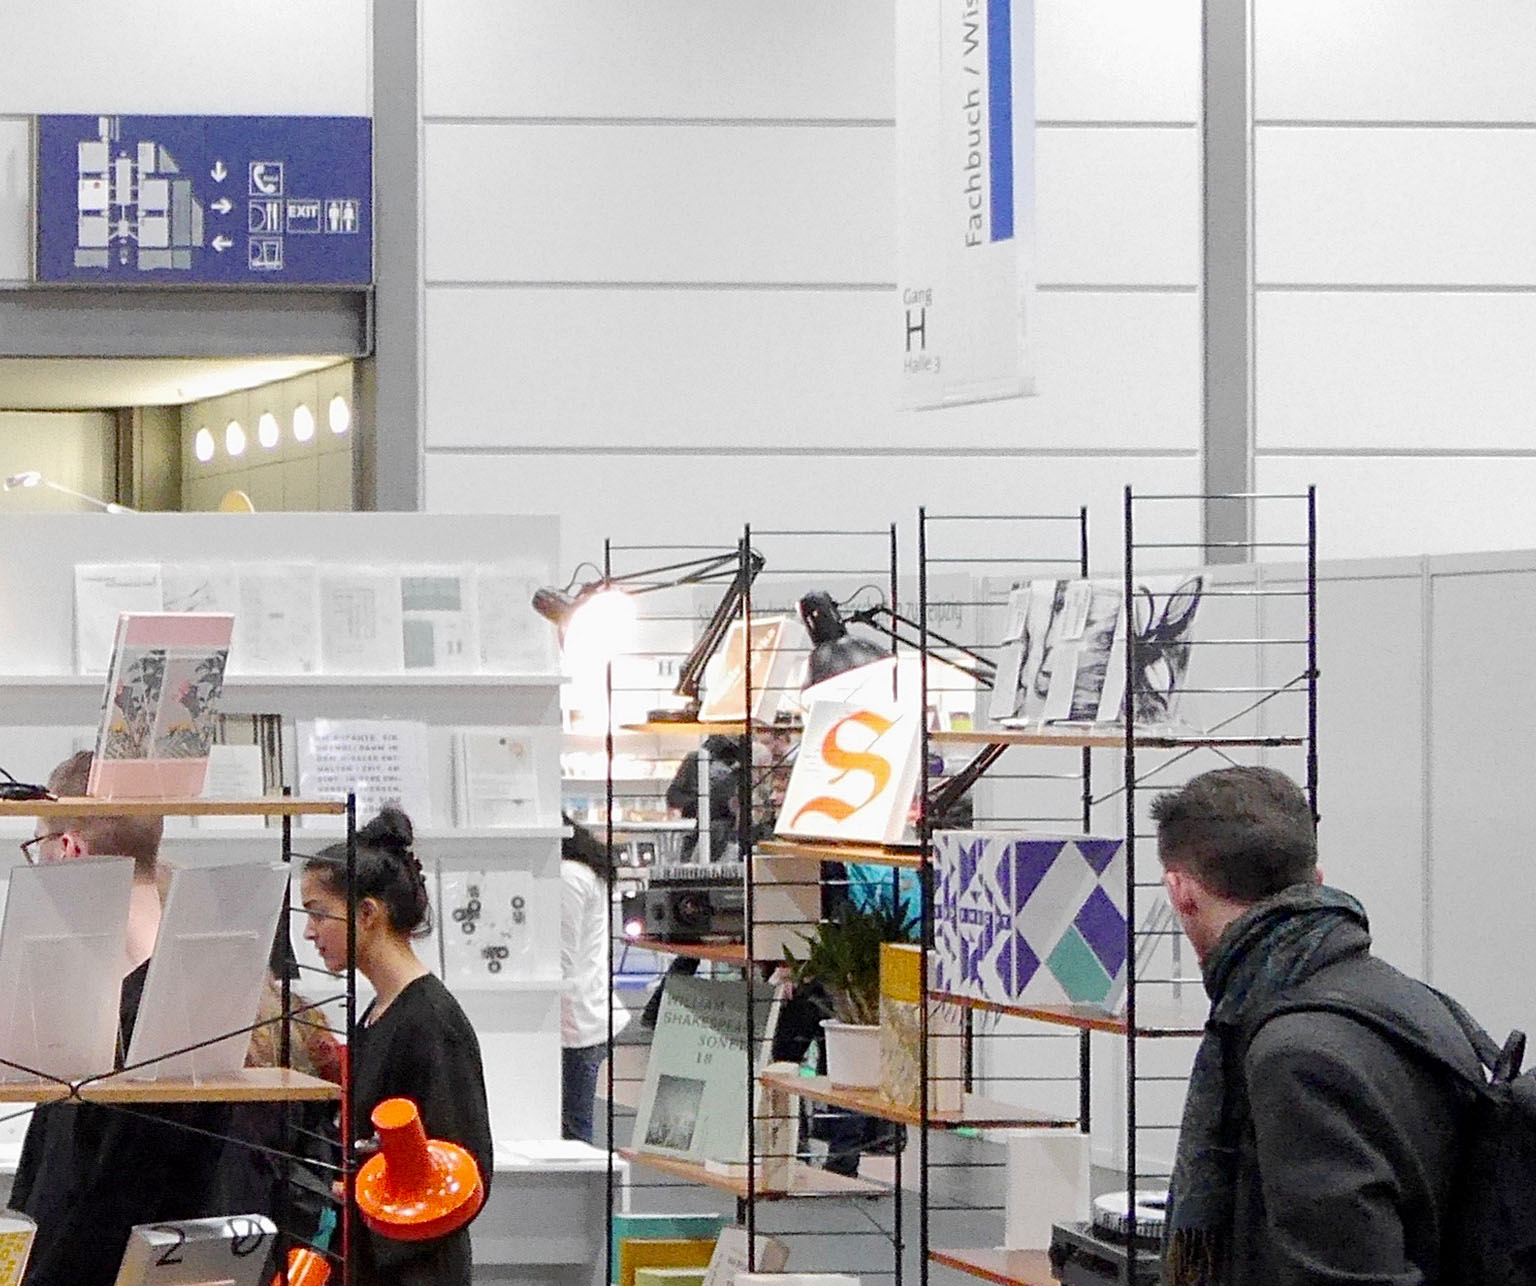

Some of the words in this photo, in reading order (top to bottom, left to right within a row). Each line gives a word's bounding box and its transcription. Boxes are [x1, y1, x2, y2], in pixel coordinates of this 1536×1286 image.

[964, 88, 983, 248] Fachbuch
[288, 205, 318, 218] EXIT
[906, 307, 926, 352] H
[790, 709, 894, 829] S
[150, 1225, 186, 1267] 2
